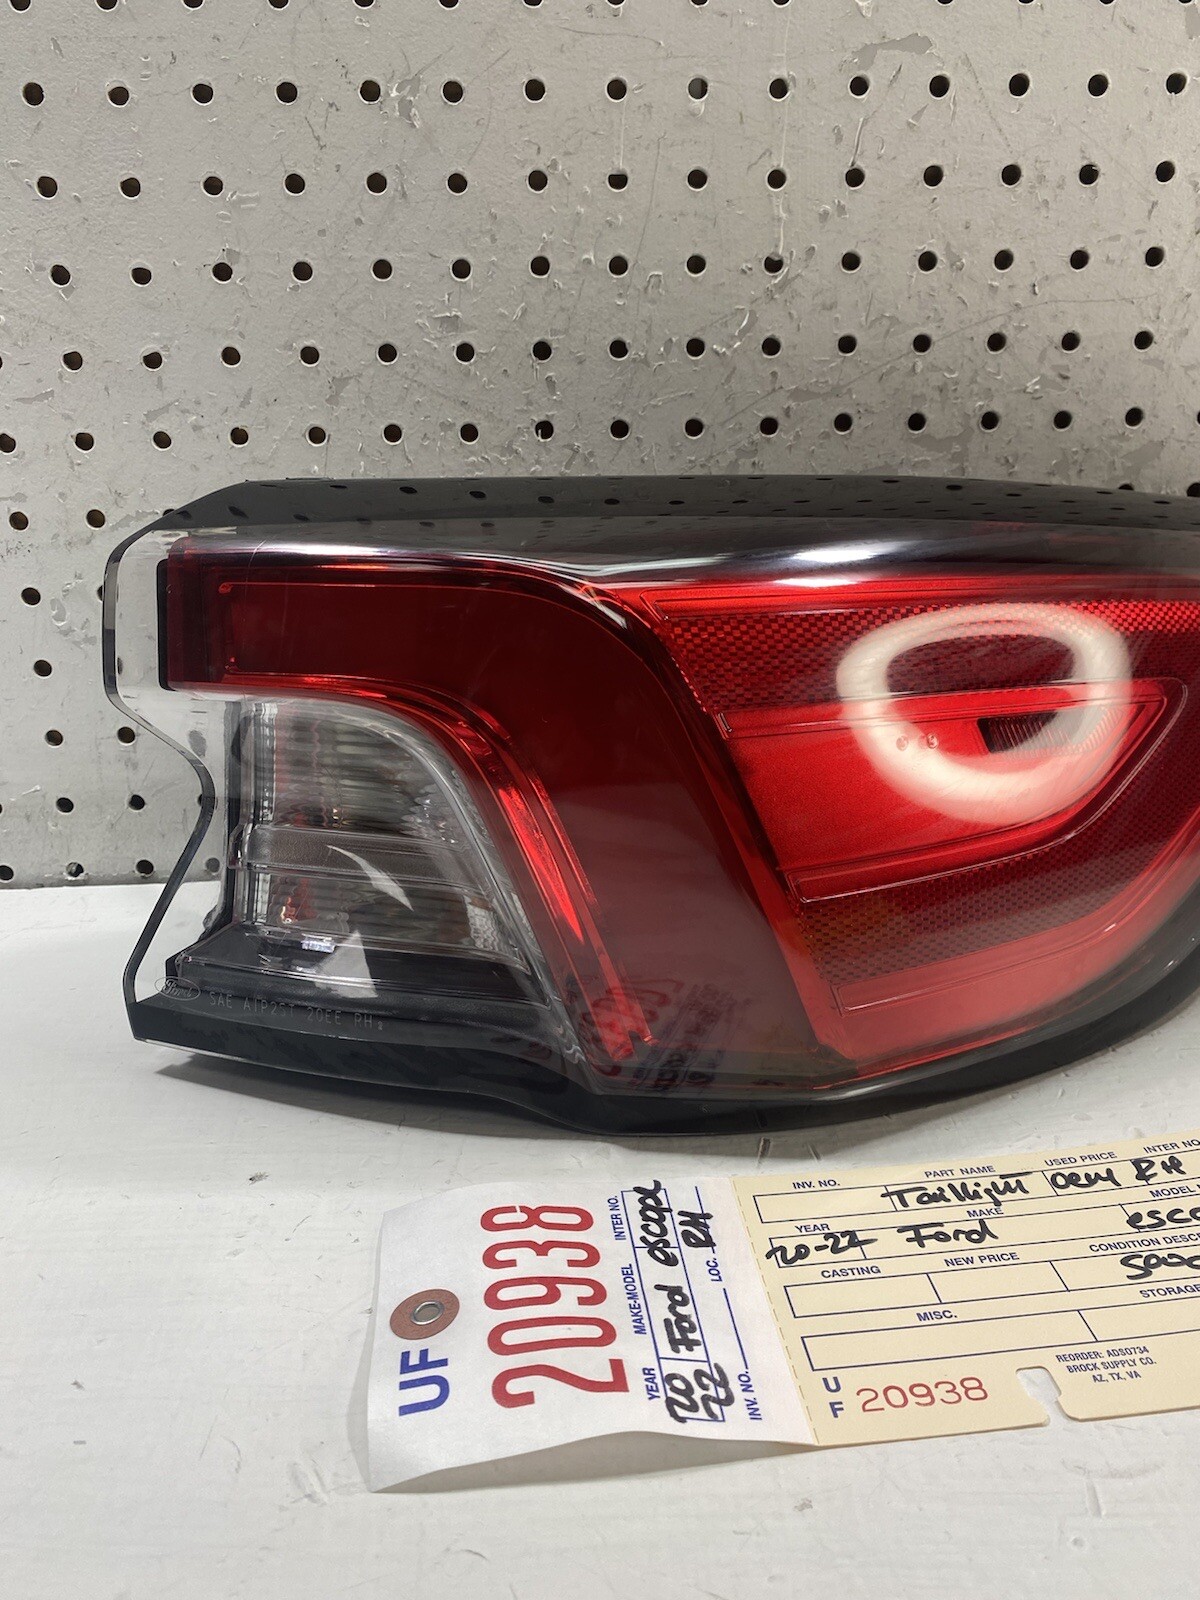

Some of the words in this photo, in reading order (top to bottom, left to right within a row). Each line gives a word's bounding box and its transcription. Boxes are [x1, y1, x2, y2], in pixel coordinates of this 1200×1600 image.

[210, 992, 233, 1009] SAE
[306, 1006, 342, 1026] 20EE
[1143, 1140, 1180, 1153] INTER
[1044, 1156, 1077, 1167] USED
[1079, 1151, 1117, 1163] PRICE
[924, 1168, 956, 1179] PART
[959, 1165, 996, 1176] NAME
[792, 1181, 815, 1190] INV.
[817, 1179, 841, 1189] NO.
[1149, 1184, 1196, 1198] MODEL
[607, 1195, 620, 1211] NO.
[967, 1208, 1004, 1219] MAKE
[614, 1211, 627, 1240] INTER
[794, 1223, 831, 1234] YEAR
[897, 1218, 999, 1248] Ford
[1089, 1236, 1160, 1253] CONDITION
[944, 1255, 977, 1267] NEW
[979, 1251, 1020, 1264] PRICE
[705, 1257, 723, 1282] LOC.
[821, 1265, 882, 1279] CASTING
[480, 1205, 629, 1408] 20938
[621, 1263, 647, 1335] MAKE-MODEL
[654, 1284, 702, 1353] Ford
[917, 1310, 957, 1322] MISC.
[1055, 1350, 1104, 1363] REORDER:
[1066, 1362, 1100, 1373] BROCK
[1100, 1358, 1137, 1370] SUPPLY
[1139, 1357, 1157, 1366] CO.
[399, 1348, 450, 1416] UF
[642, 1367, 661, 1400] YEAR
[738, 1370, 755, 1393] NO.
[822, 1376, 842, 1393] U
[1092, 1373, 1109, 1383] AZ,
[1109, 1371, 1126, 1382] TX,
[1126, 1369, 1142, 1379] VA
[664, 1372, 699, 1423] 20
[856, 1376, 988, 1413] 20938
[746, 1397, 762, 1420] INV.
[829, 1401, 845, 1419] F
